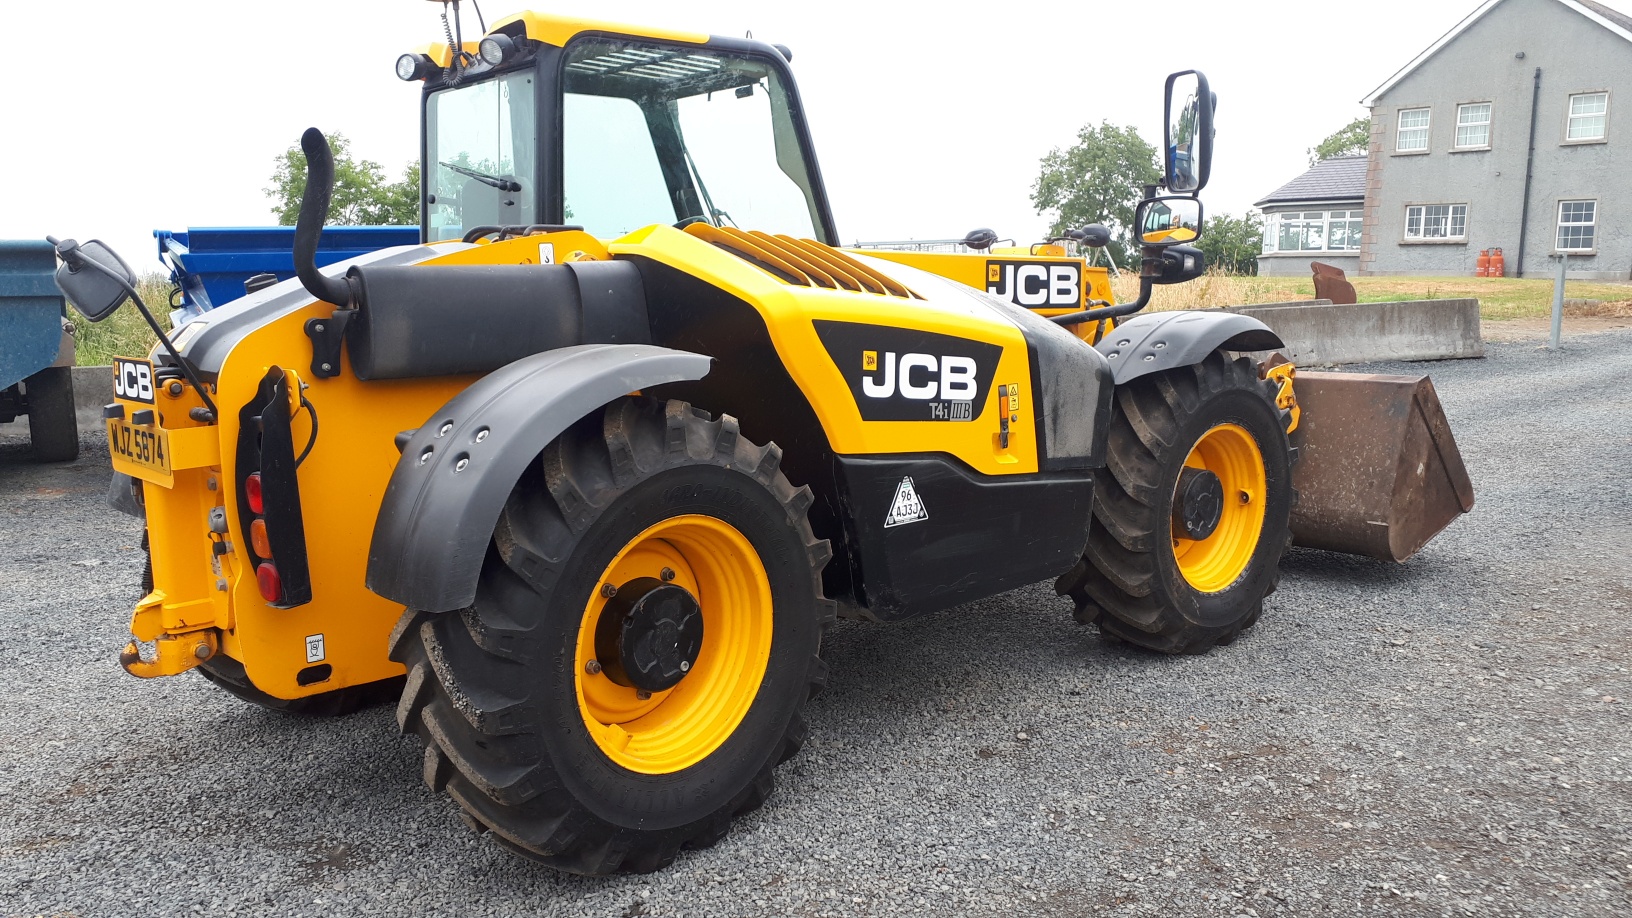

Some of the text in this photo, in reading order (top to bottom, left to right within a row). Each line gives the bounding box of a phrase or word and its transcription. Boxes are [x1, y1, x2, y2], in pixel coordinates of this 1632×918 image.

[988, 264, 1079, 305] JCB
[115, 361, 153, 400] JCB
[862, 351, 978, 400] JCB
[928, 402, 949, 419] T4i
[110, 422, 164, 467] WJZ 5874
[896, 503, 919, 518] AJ3J
[901, 489, 912, 502] 96
